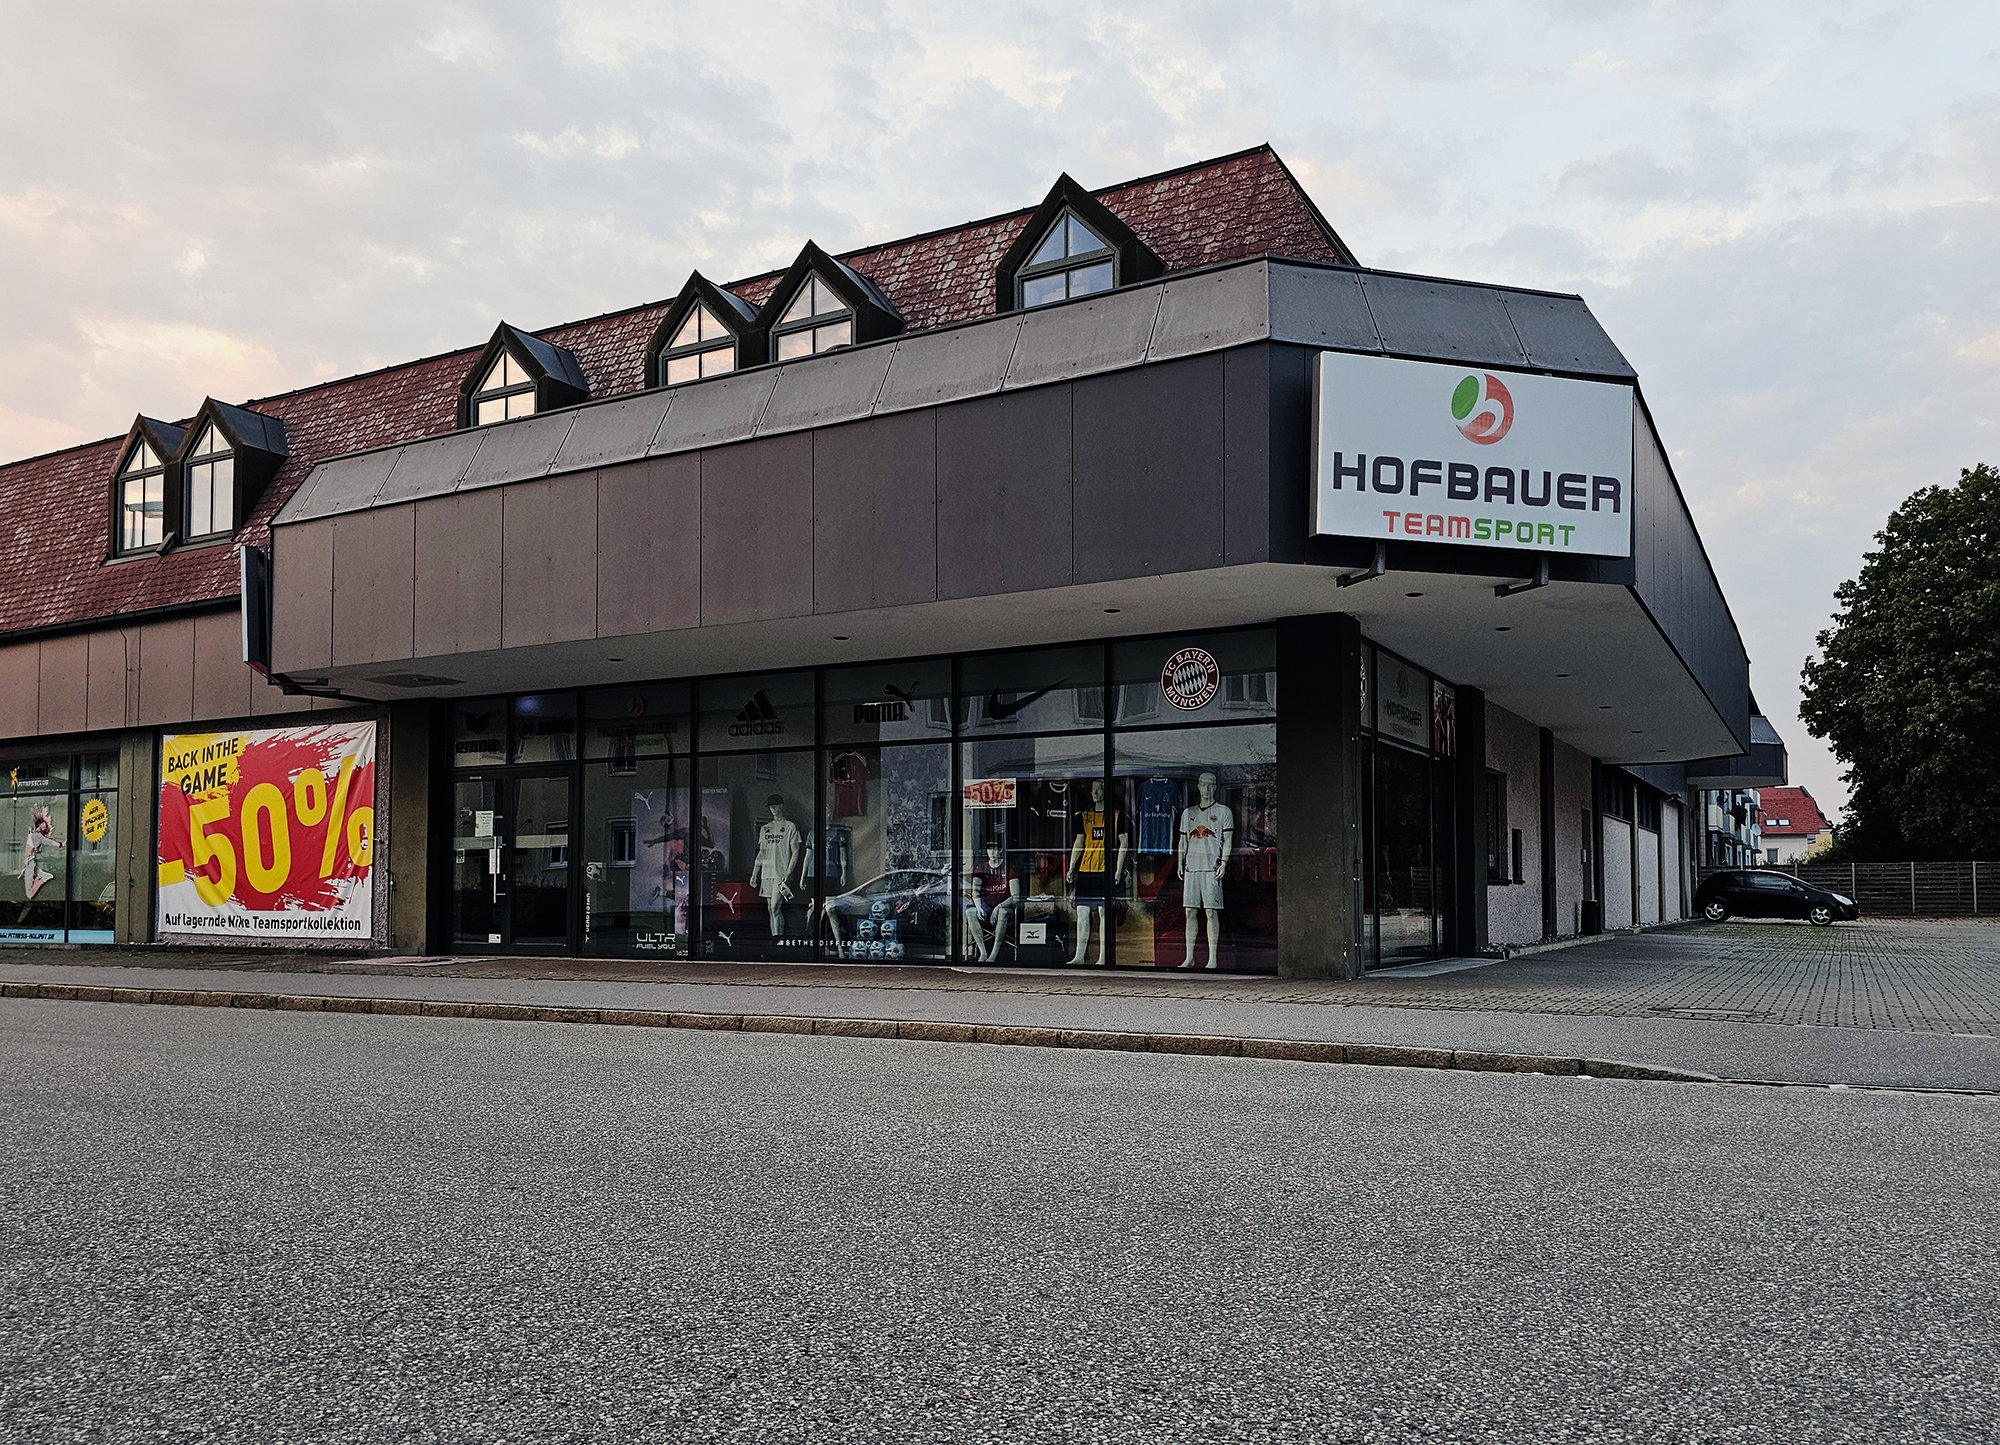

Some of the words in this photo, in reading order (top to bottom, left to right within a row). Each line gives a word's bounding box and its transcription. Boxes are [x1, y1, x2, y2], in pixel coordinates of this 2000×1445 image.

[1332, 451, 1621, 513] HOFBAUER
[1383, 510, 1576, 546] TEAMSPORT
[1165, 663, 1176, 677] FC
[1176, 651, 1215, 673] BAYERN
[728, 718, 782, 736] adidas
[853, 702, 904, 723] PUMA
[168, 750, 199, 773] BACK
[202, 745, 214, 763] IN
[216, 737, 239, 759] THE
[181, 763, 227, 796] GAME
[165, 913, 182, 926] Auf
[183, 913, 226, 928] lagernde
[253, 916, 361, 932] Teamsportkollektion
